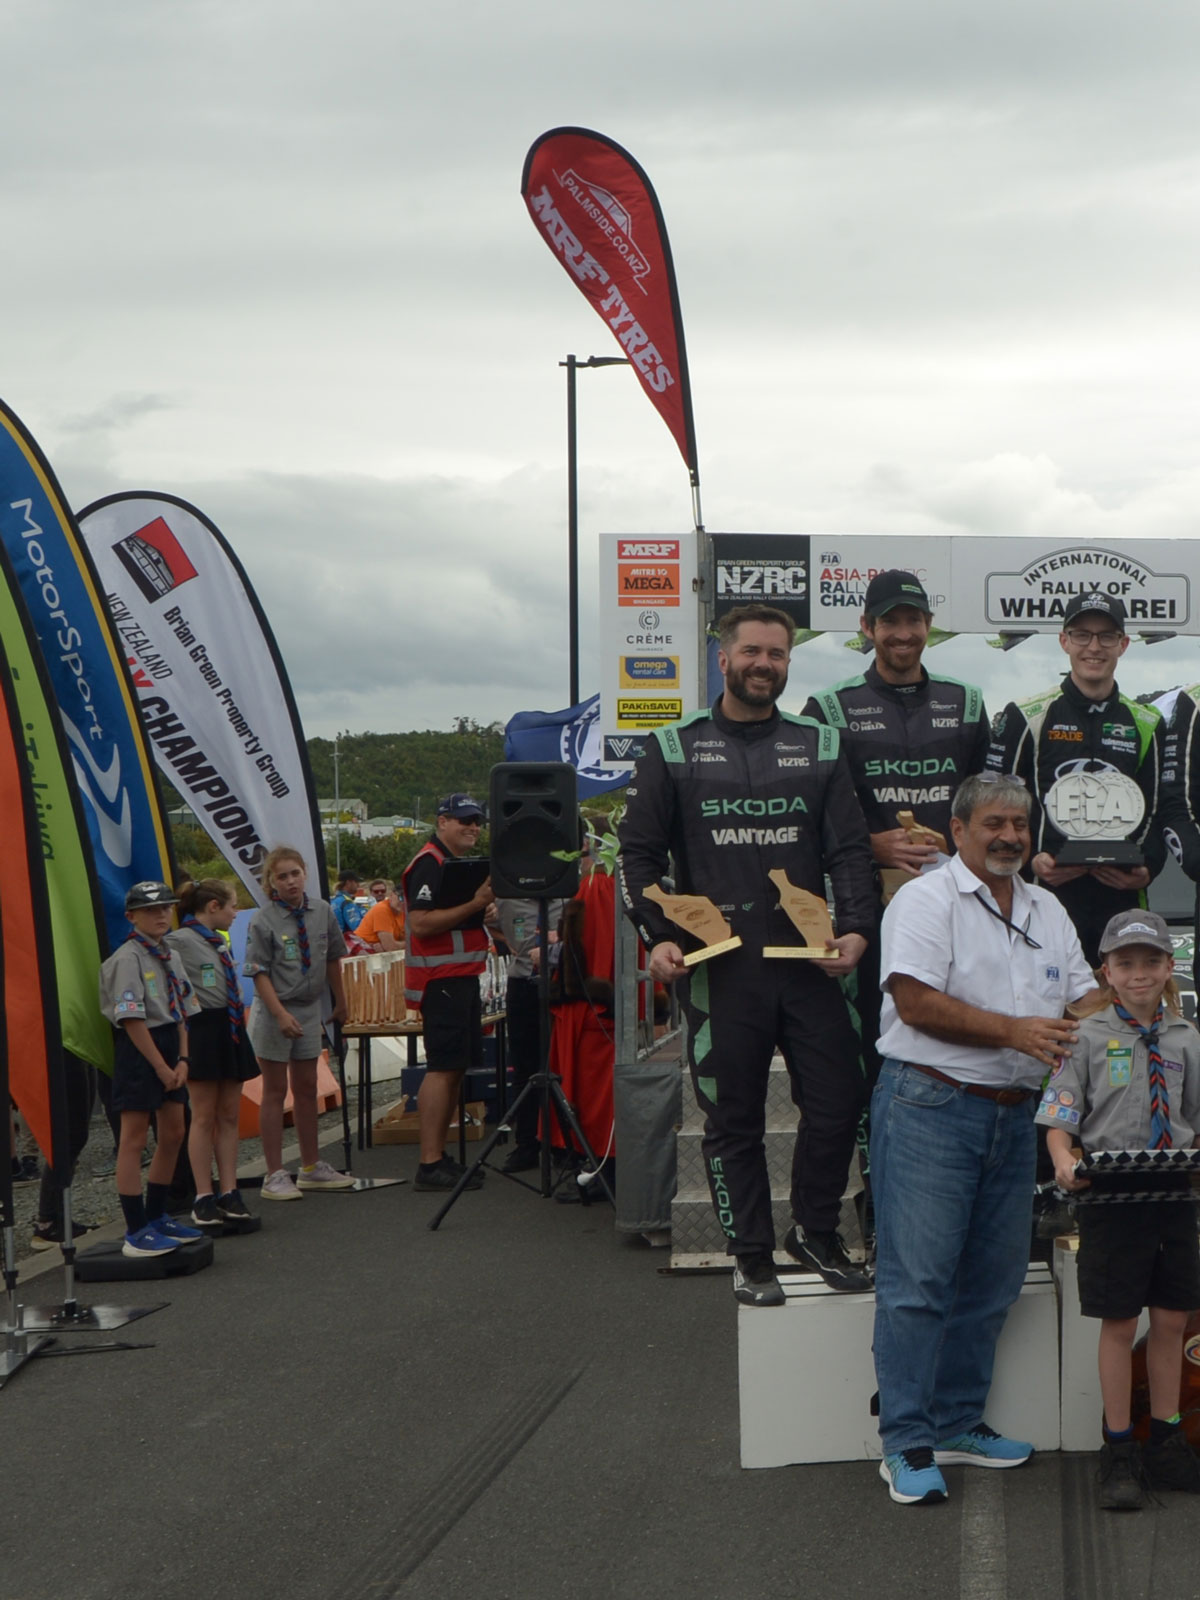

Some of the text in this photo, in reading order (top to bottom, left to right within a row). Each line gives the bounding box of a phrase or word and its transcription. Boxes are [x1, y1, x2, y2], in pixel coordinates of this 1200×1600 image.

[563, 177, 645, 278] PALMSIDE.CO.NZ
[530, 184, 674, 393] MRF TYRES
[621, 543, 676, 556] MRF
[630, 568, 668, 576] MITRE 10
[1024, 553, 1147, 587] INTERNATIONAL
[624, 577, 674, 590] MEGA
[717, 566, 806, 594] NZRC
[1042, 582, 1132, 595] RALLY OF
[106, 593, 133, 623] NEW
[10, 497, 104, 741] MotorSport
[119, 622, 173, 681] ZEALAND
[633, 661, 667, 670] omega
[163, 606, 290, 800] Brian Green Property Group
[932, 718, 959, 728] NZRC
[1048, 731, 1084, 741] TRADE
[778, 757, 810, 768] NZRC
[865, 758, 957, 776] SKODA
[873, 786, 950, 804] VANTAGE
[702, 797, 808, 817] SKODA
[711, 827, 799, 845] VANTAGE
